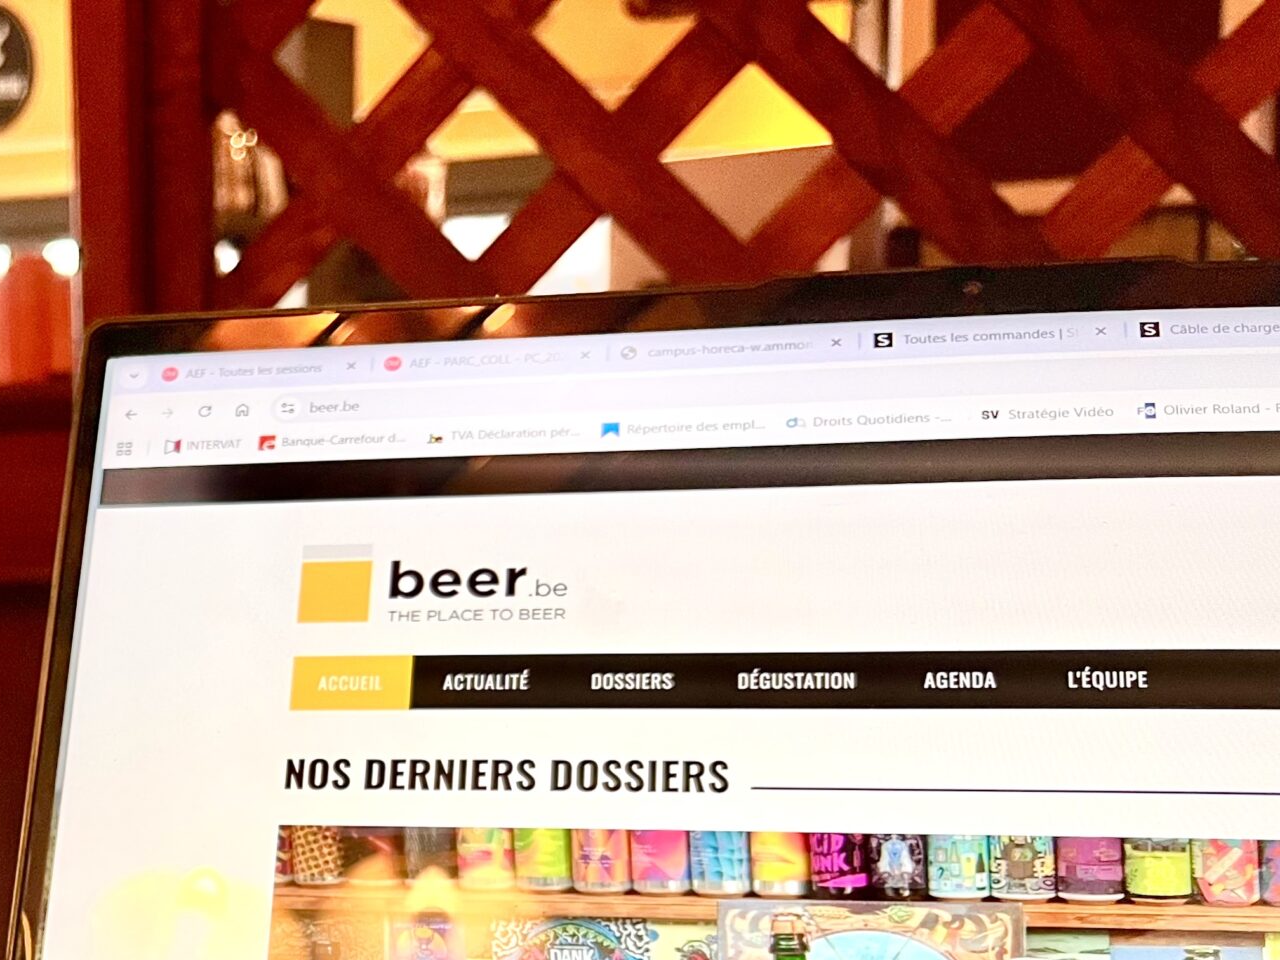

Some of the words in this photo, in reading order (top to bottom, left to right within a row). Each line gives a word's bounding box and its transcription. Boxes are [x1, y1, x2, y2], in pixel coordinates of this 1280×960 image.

[1170, 323, 1208, 335] Câble
[1213, 323, 1229, 334] de
[904, 333, 947, 345] Toutes
[951, 332, 968, 343] les
[973, 328, 1055, 342] commandes
[219, 366, 254, 378] Toutes
[257, 365, 272, 376] les
[276, 363, 322, 375] sessions
[309, 401, 360, 414] beer.be
[981, 409, 999, 419] SV
[1008, 406, 1070, 422] Stratégie
[1074, 405, 1114, 418] Vidéo
[1164, 404, 1207, 416] Olivier
[1212, 403, 1260, 415] Roland
[813, 416, 852, 427] Droits
[857, 413, 930, 426] Quotidiens
[451, 430, 474, 441] TVA
[478, 428, 547, 440] Déclaration
[627, 422, 696, 436] Répertoire
[698, 421, 719, 432] des
[186, 439, 242, 451] INTERVAT
[281, 434, 385, 448] Banque-Carrefour
[389, 610, 420, 622] THE
[427, 608, 483, 621] PLACE
[490, 608, 514, 621] TO
[520, 607, 566, 620] BEER
[318, 675, 383, 692] ACCUEIL
[442, 669, 531, 692] ACTUALITÉ
[590, 673, 675, 690] DOSSIERS
[737, 668, 857, 690] DÉGUSTATION
[923, 671, 997, 689] AGENDA
[1068, 666, 1149, 690] L'ÉQUIPE
[284, 759, 351, 790] NOS
[364, 759, 537, 791] DERNIERS
[549, 760, 730, 793] DOSSIERS
